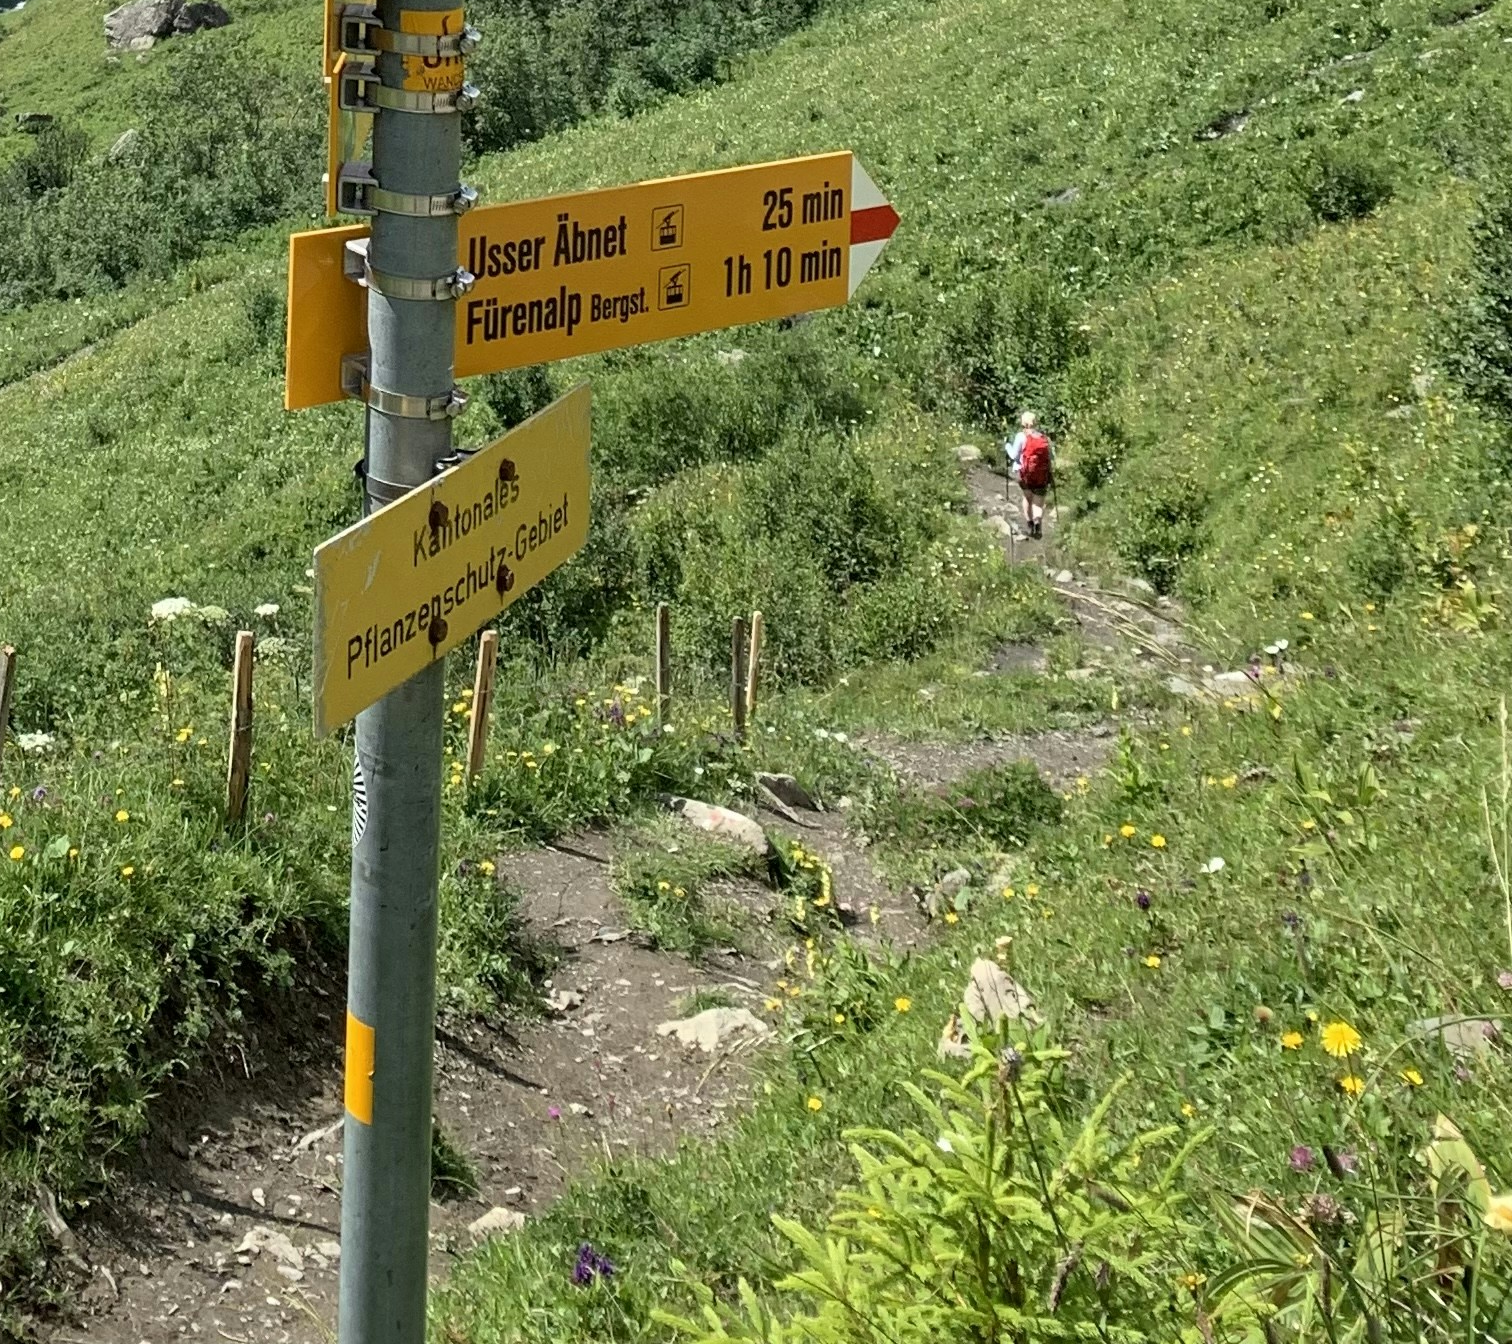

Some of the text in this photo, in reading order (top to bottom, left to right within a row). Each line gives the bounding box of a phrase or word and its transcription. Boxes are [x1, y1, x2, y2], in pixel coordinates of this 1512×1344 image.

[468, 181, 843, 280] Usser Äbnet 25 min
[467, 240, 841, 345] Fürenalp Bergst. 1h 10 min
[413, 475, 520, 567] Kantonales
[348, 492, 569, 679] Pflanzenschutz-Gebiet
